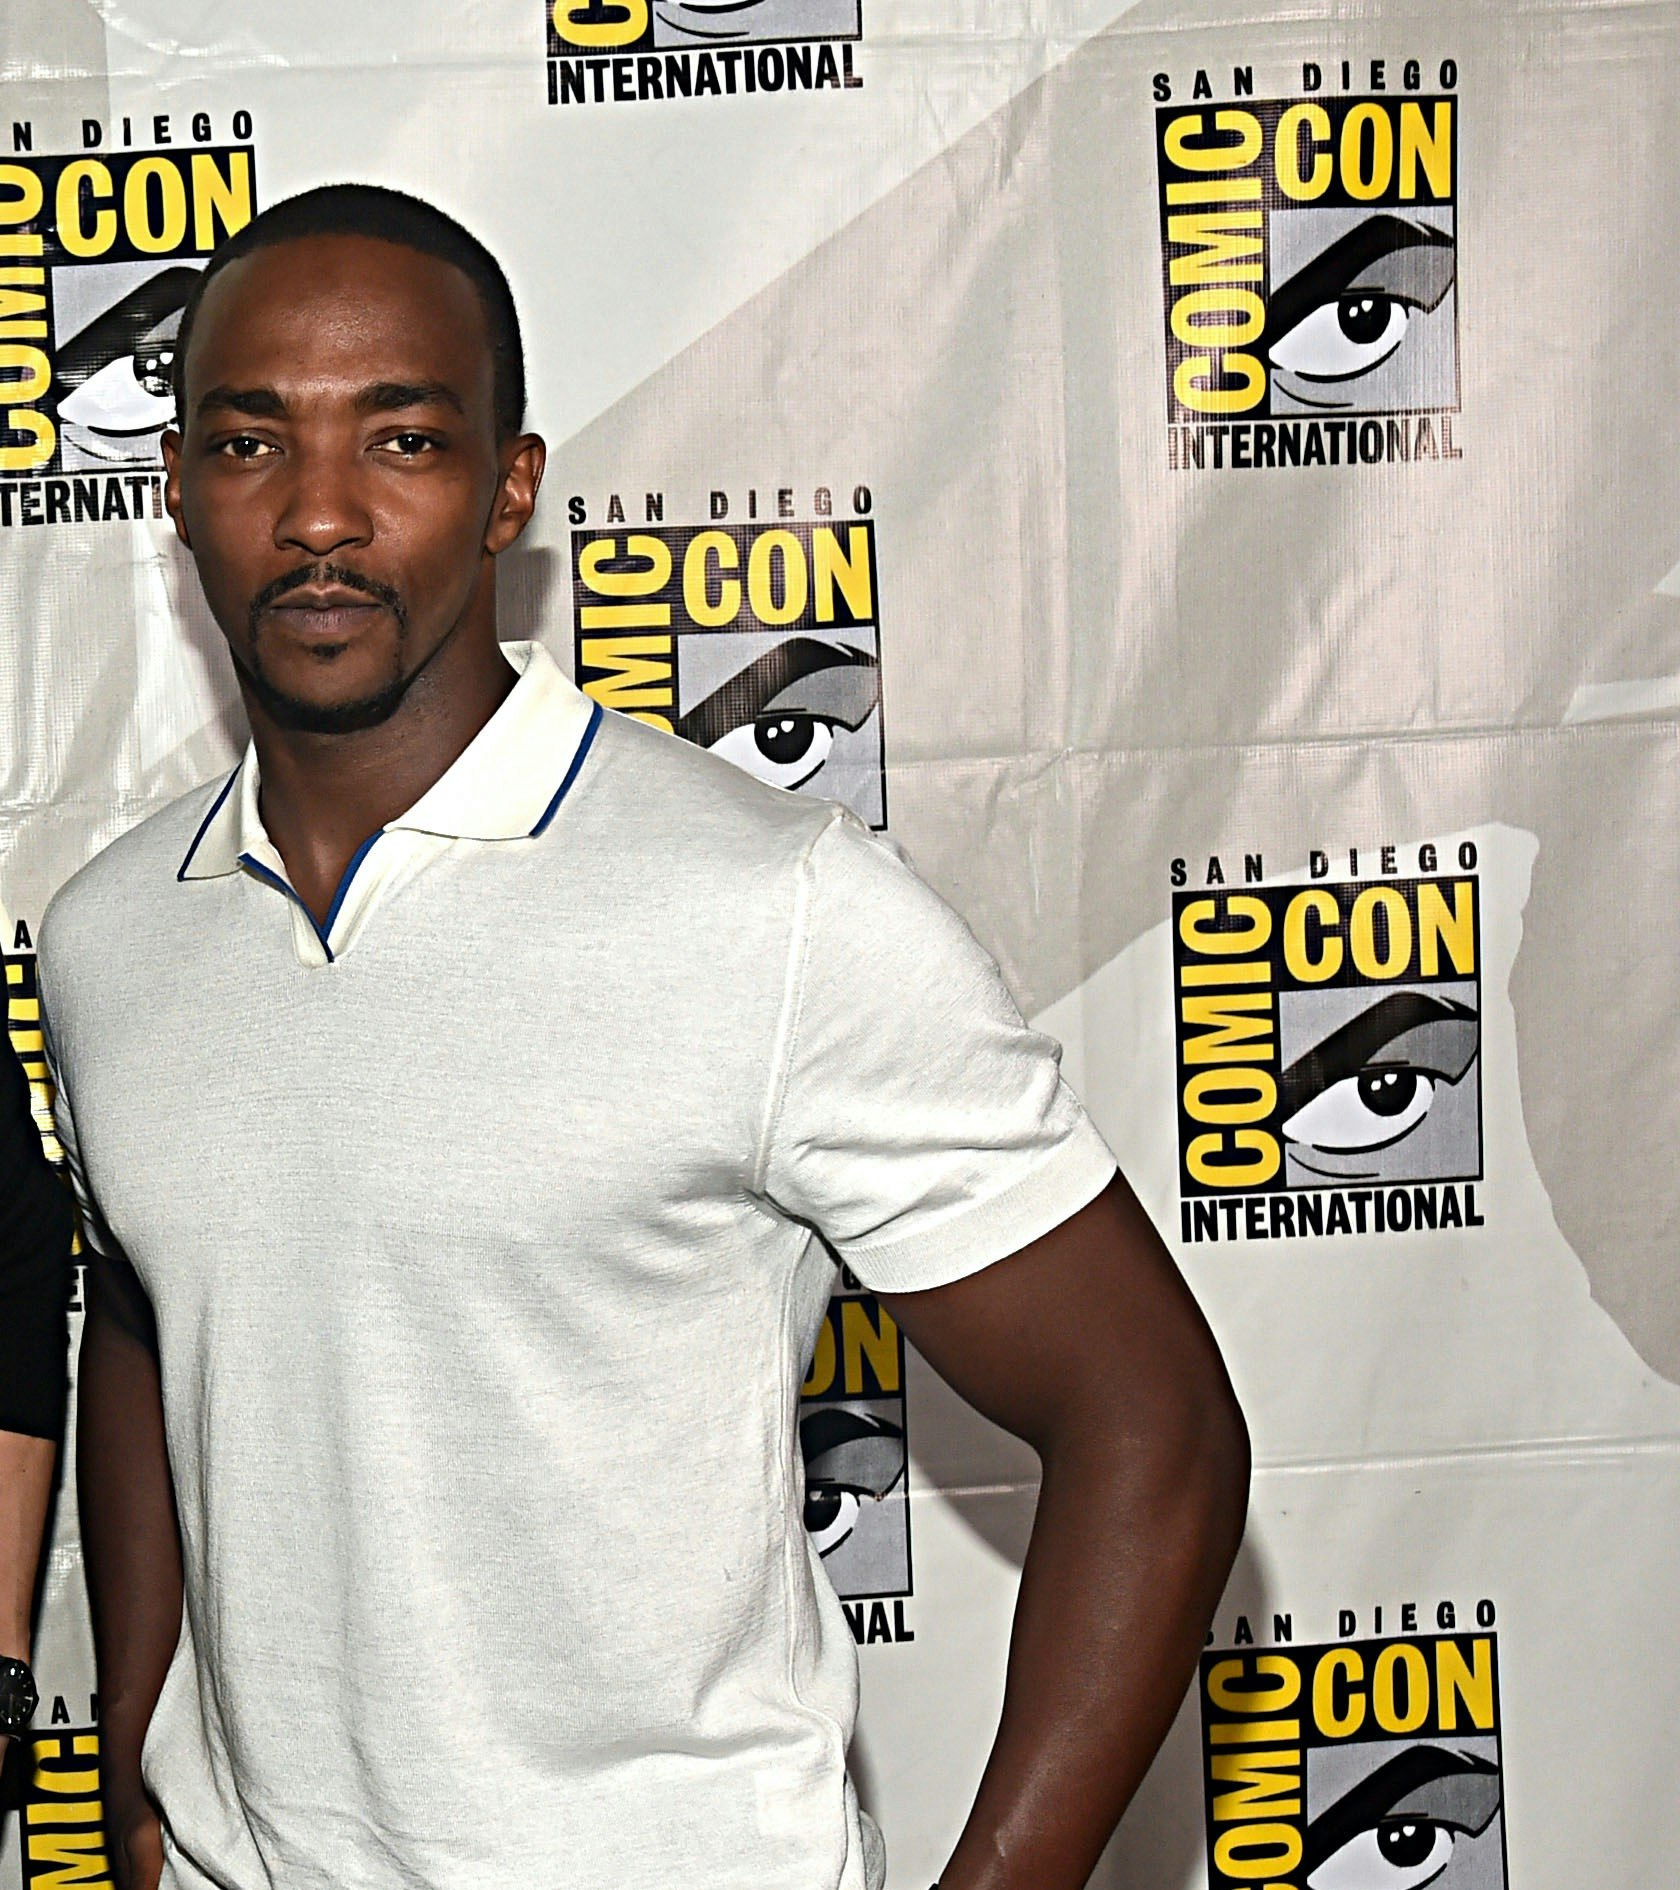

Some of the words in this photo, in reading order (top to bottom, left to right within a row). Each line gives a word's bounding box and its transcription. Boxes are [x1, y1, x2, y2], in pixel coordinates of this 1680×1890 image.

[546, 43, 864, 105] INTERNATIONAL
[1152, 66, 1253, 102] SAN
[1302, 59, 1458, 92] DIEGO
[83, 110, 253, 148] DIEGO
[1272, 100, 1453, 202] CON
[55, 151, 253, 258] CON
[1163, 108, 1268, 415] COMIC
[1168, 415, 1463, 470] INTERNATIONAL
[568, 493, 664, 525] SAN
[710, 486, 872, 520] DIEGO
[682, 525, 873, 628] CON
[577, 534, 675, 733] MIC
[1170, 854, 1263, 887] SAN
[1309, 842, 1478, 878] DIEGO
[1283, 880, 1476, 983] CON
[1178, 895, 1281, 1189] COMIC
[1180, 1184, 1485, 1243] INTERNATIONAL
[1338, 1599, 1497, 1638] DIEGO
[1312, 1638, 1495, 1739] CON
[26, 1735, 116, 1890] MIC
[1207, 1655, 1304, 1890] OMIC
